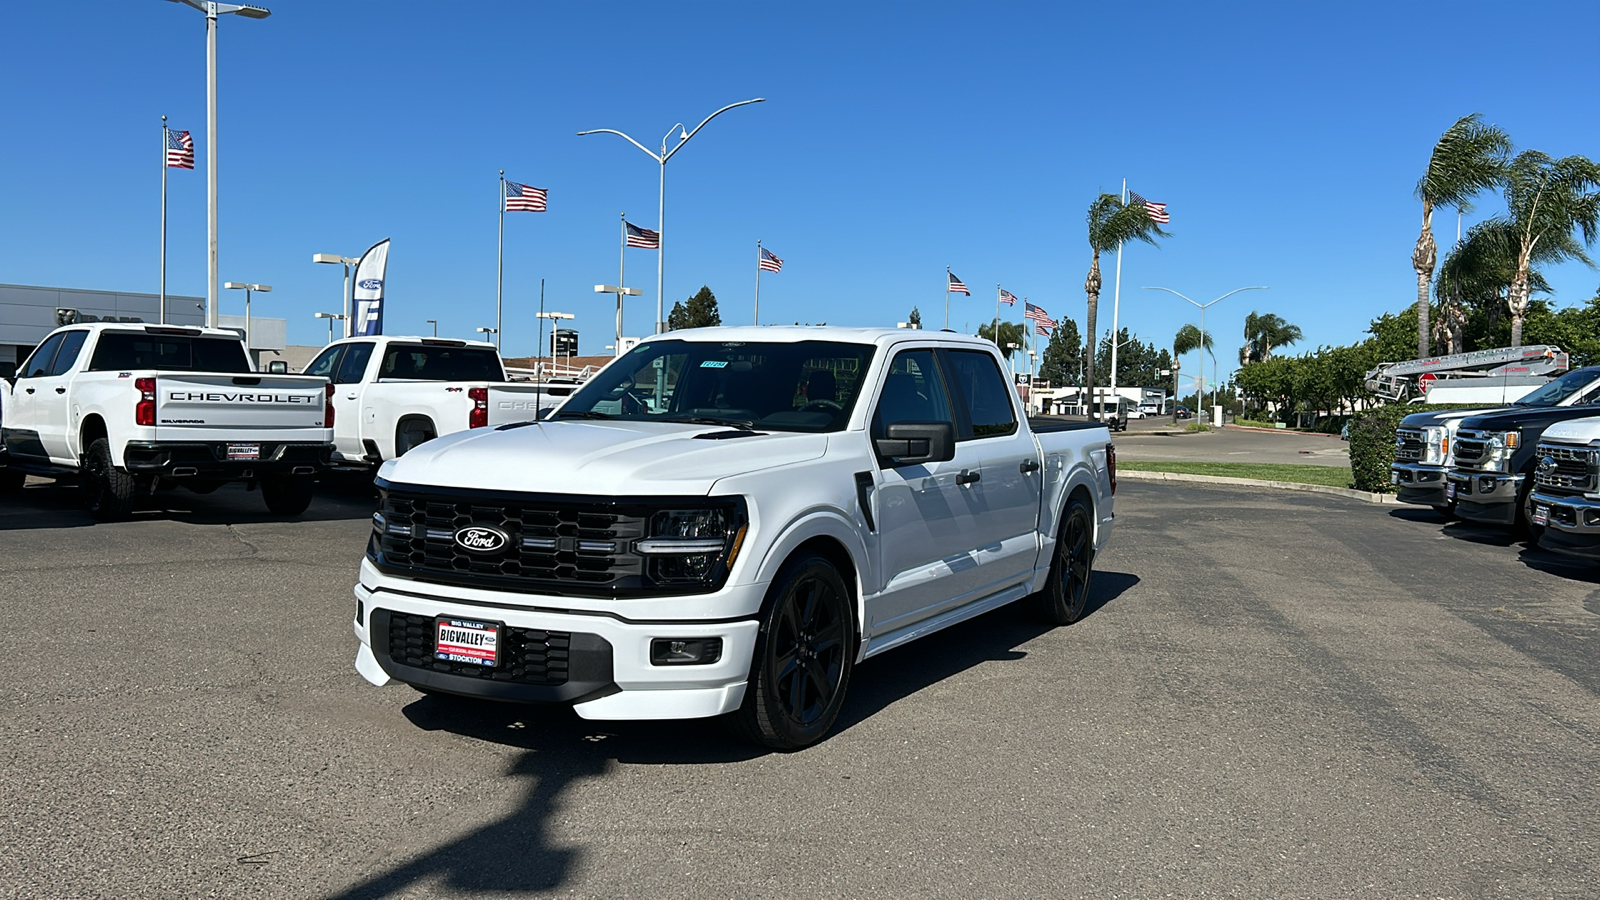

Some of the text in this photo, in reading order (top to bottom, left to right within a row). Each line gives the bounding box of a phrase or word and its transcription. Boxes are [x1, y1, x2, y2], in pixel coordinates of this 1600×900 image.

[169, 392, 316, 403] CHEVROLET
[464, 529, 495, 548] Ford
[462, 621, 484, 629] VALLEY
[440, 629, 485, 646] BIGVALLEY
[448, 654, 482, 664] STOCKTON
